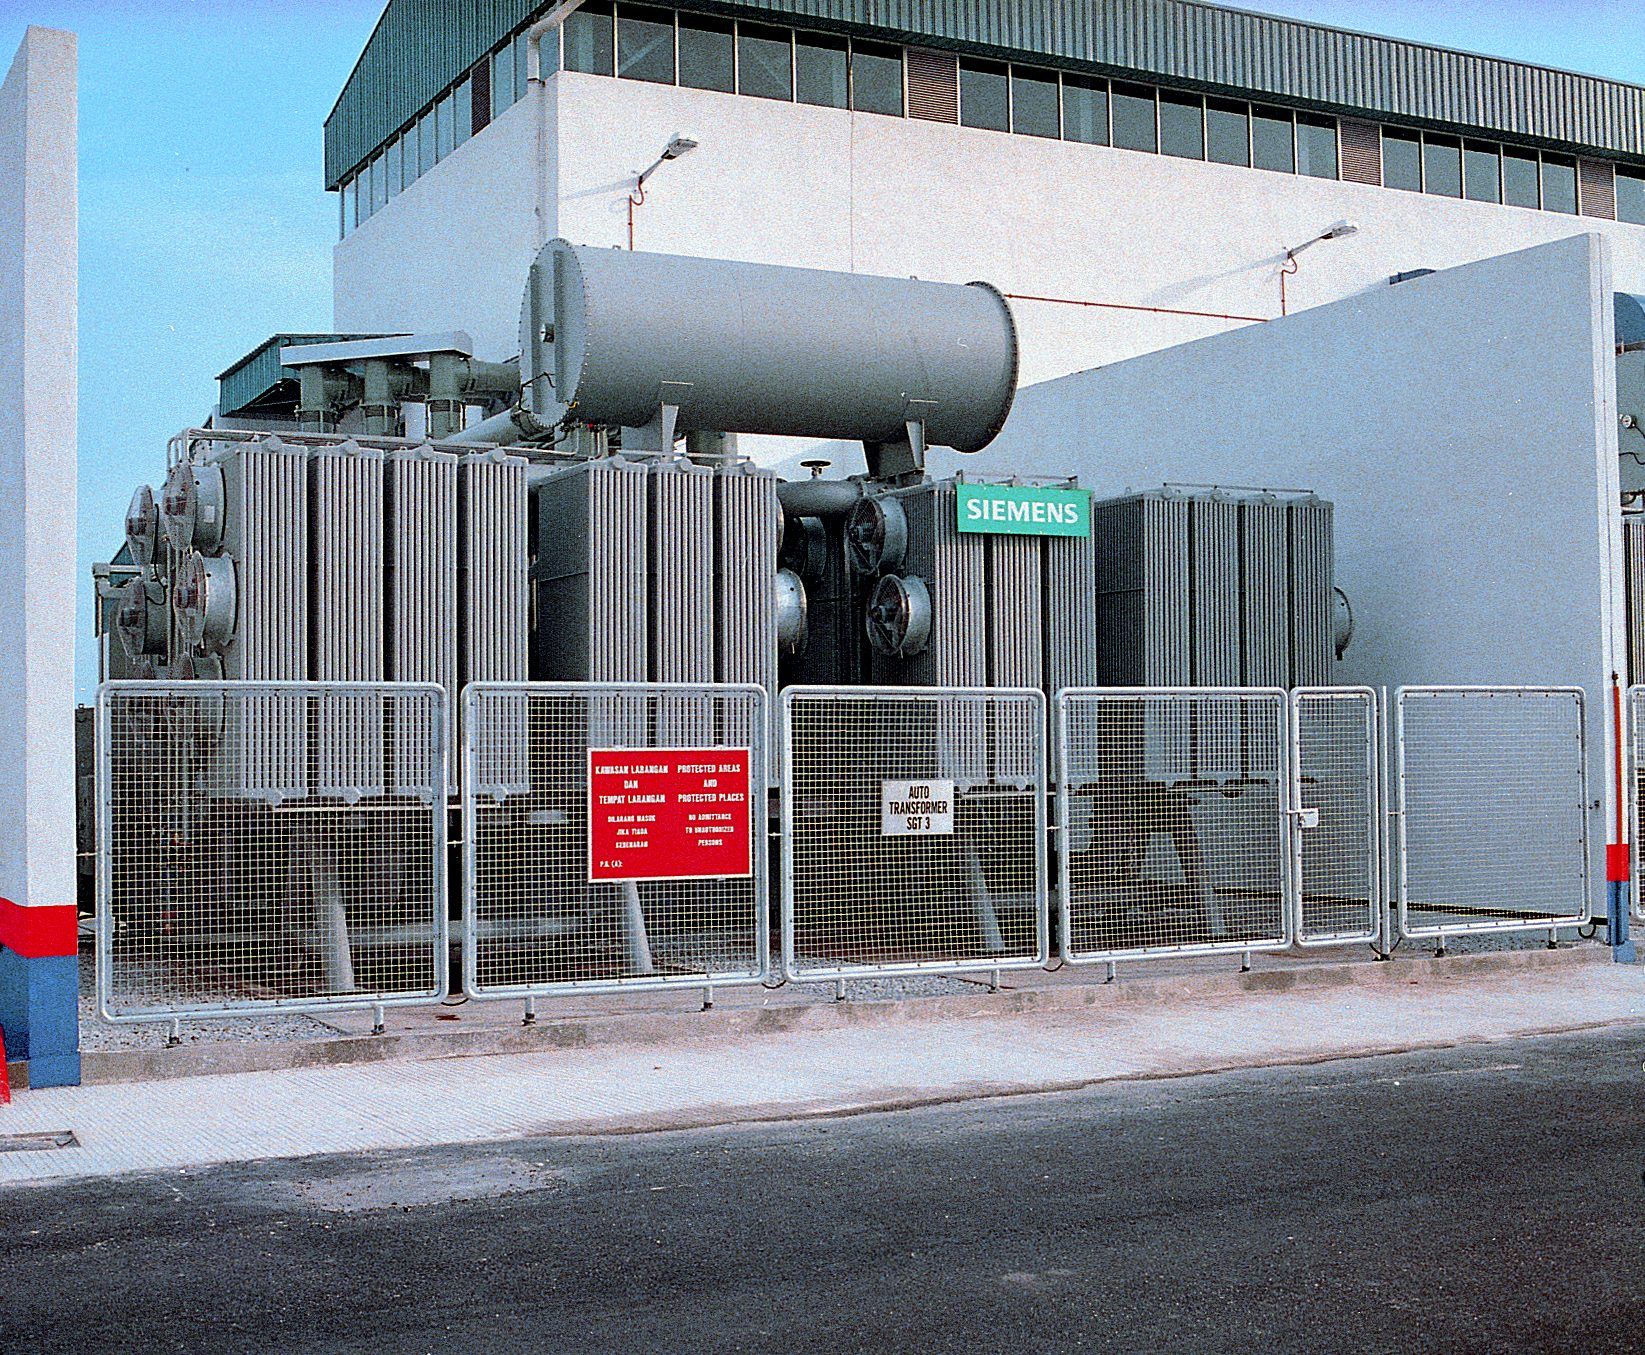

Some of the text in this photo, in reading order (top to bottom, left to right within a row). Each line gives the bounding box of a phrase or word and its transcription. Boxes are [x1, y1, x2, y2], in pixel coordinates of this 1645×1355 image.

[966, 498, 1079, 524] SIEMENS
[677, 764, 741, 774] PROTECTED AREAS
[623, 780, 639, 790] DAN
[703, 779, 718, 788] AND
[908, 785, 930, 799] AUTO
[599, 794, 666, 805] TEMPAT LARANGAN
[677, 793, 745, 803] PROTECTED PLACES
[889, 801, 948, 815] TRANSFORMER
[906, 816, 931, 830] SGT 3
